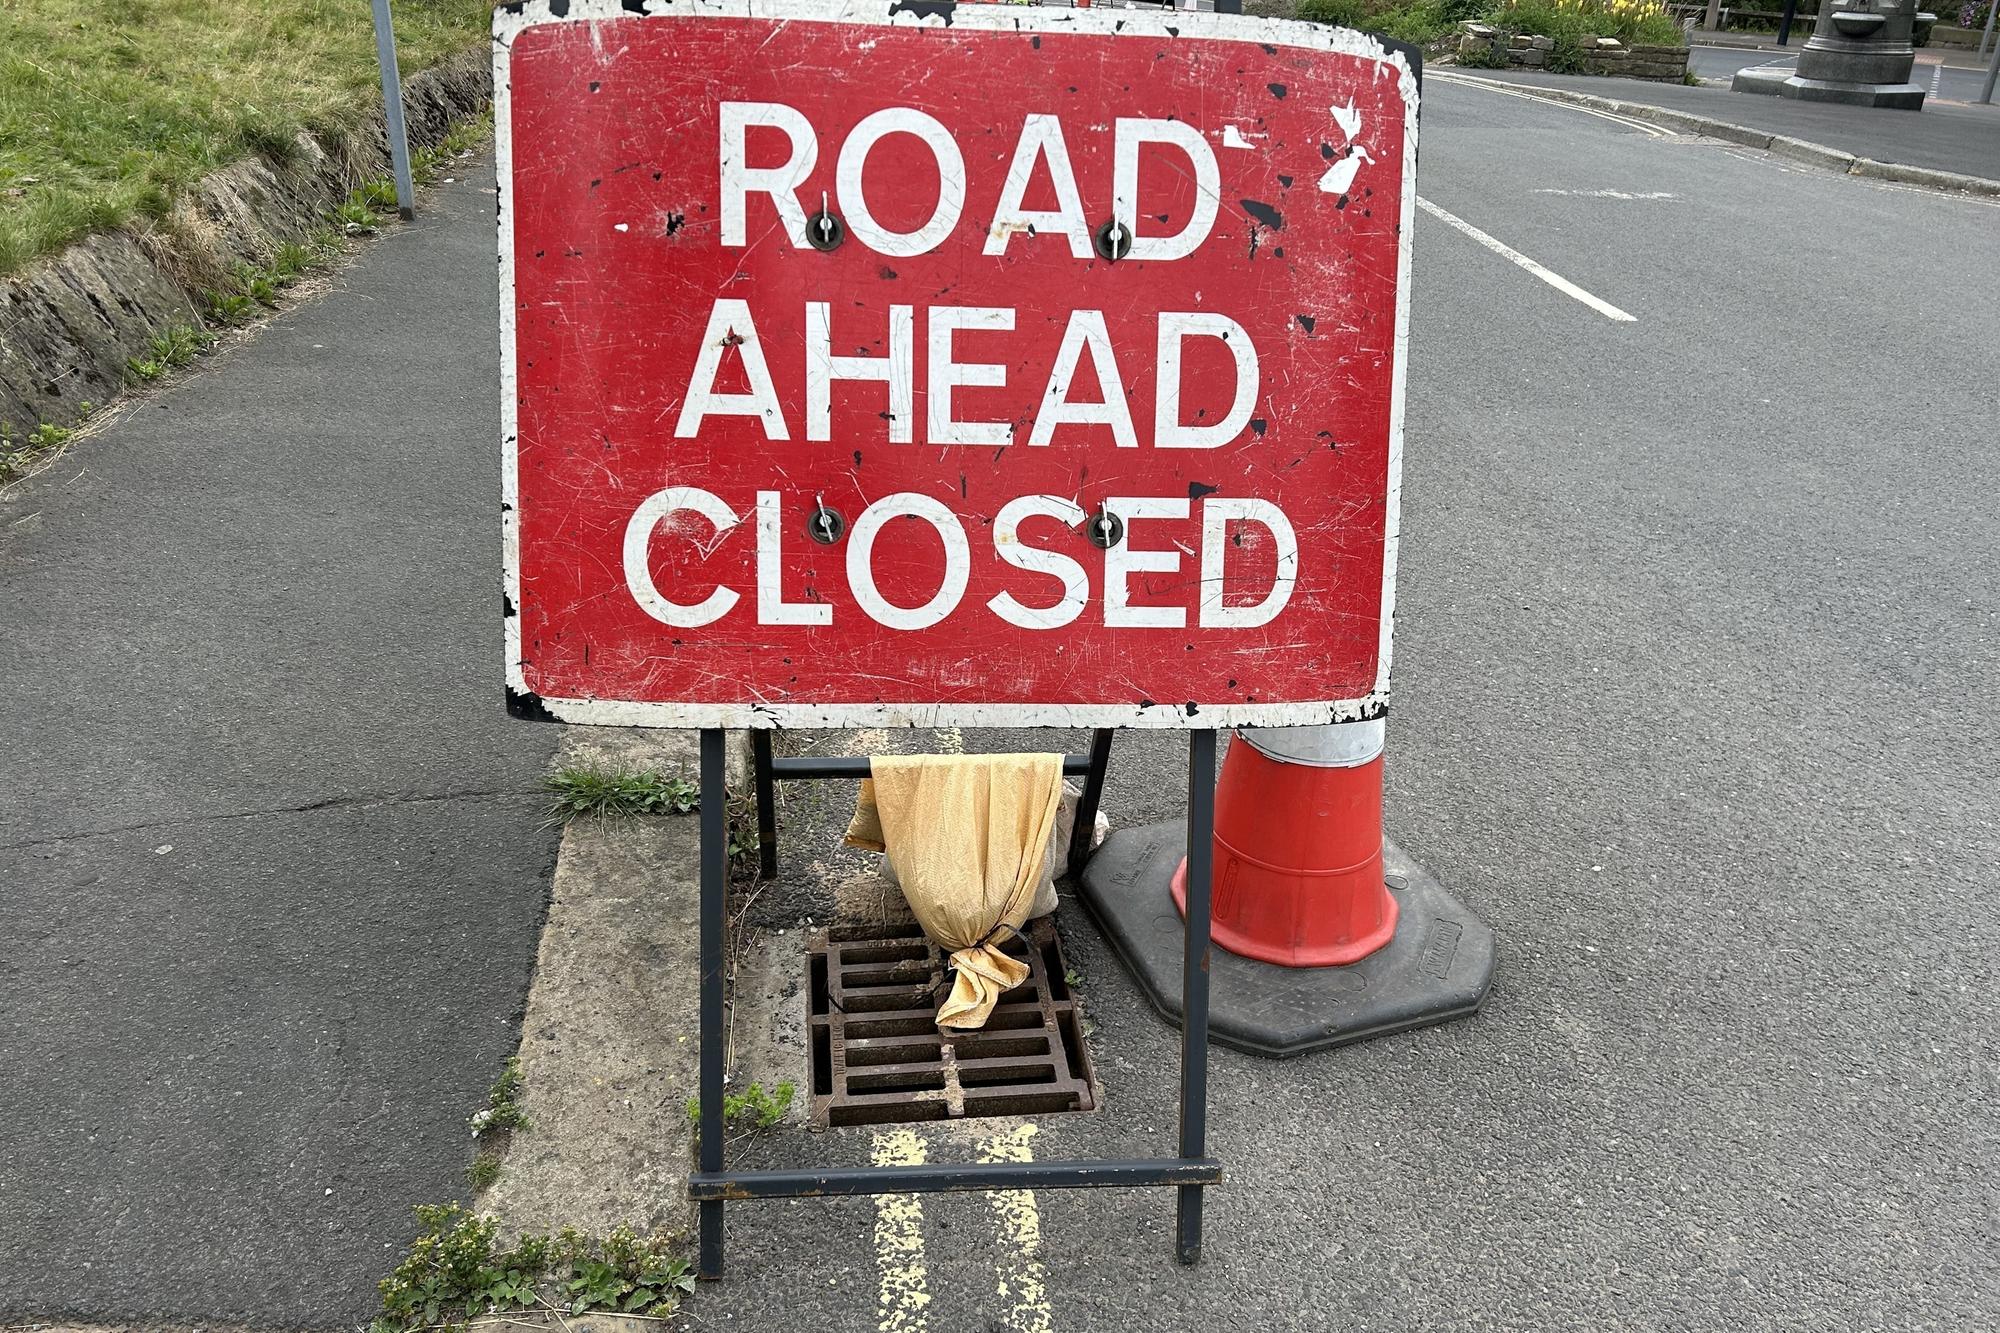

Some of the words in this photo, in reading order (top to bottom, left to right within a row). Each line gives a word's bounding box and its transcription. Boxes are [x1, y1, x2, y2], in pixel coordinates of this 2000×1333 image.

[719, 101, 1221, 261] ROAD
[674, 298, 1260, 449] AHEAD
[622, 486, 1299, 630] CLOSED
